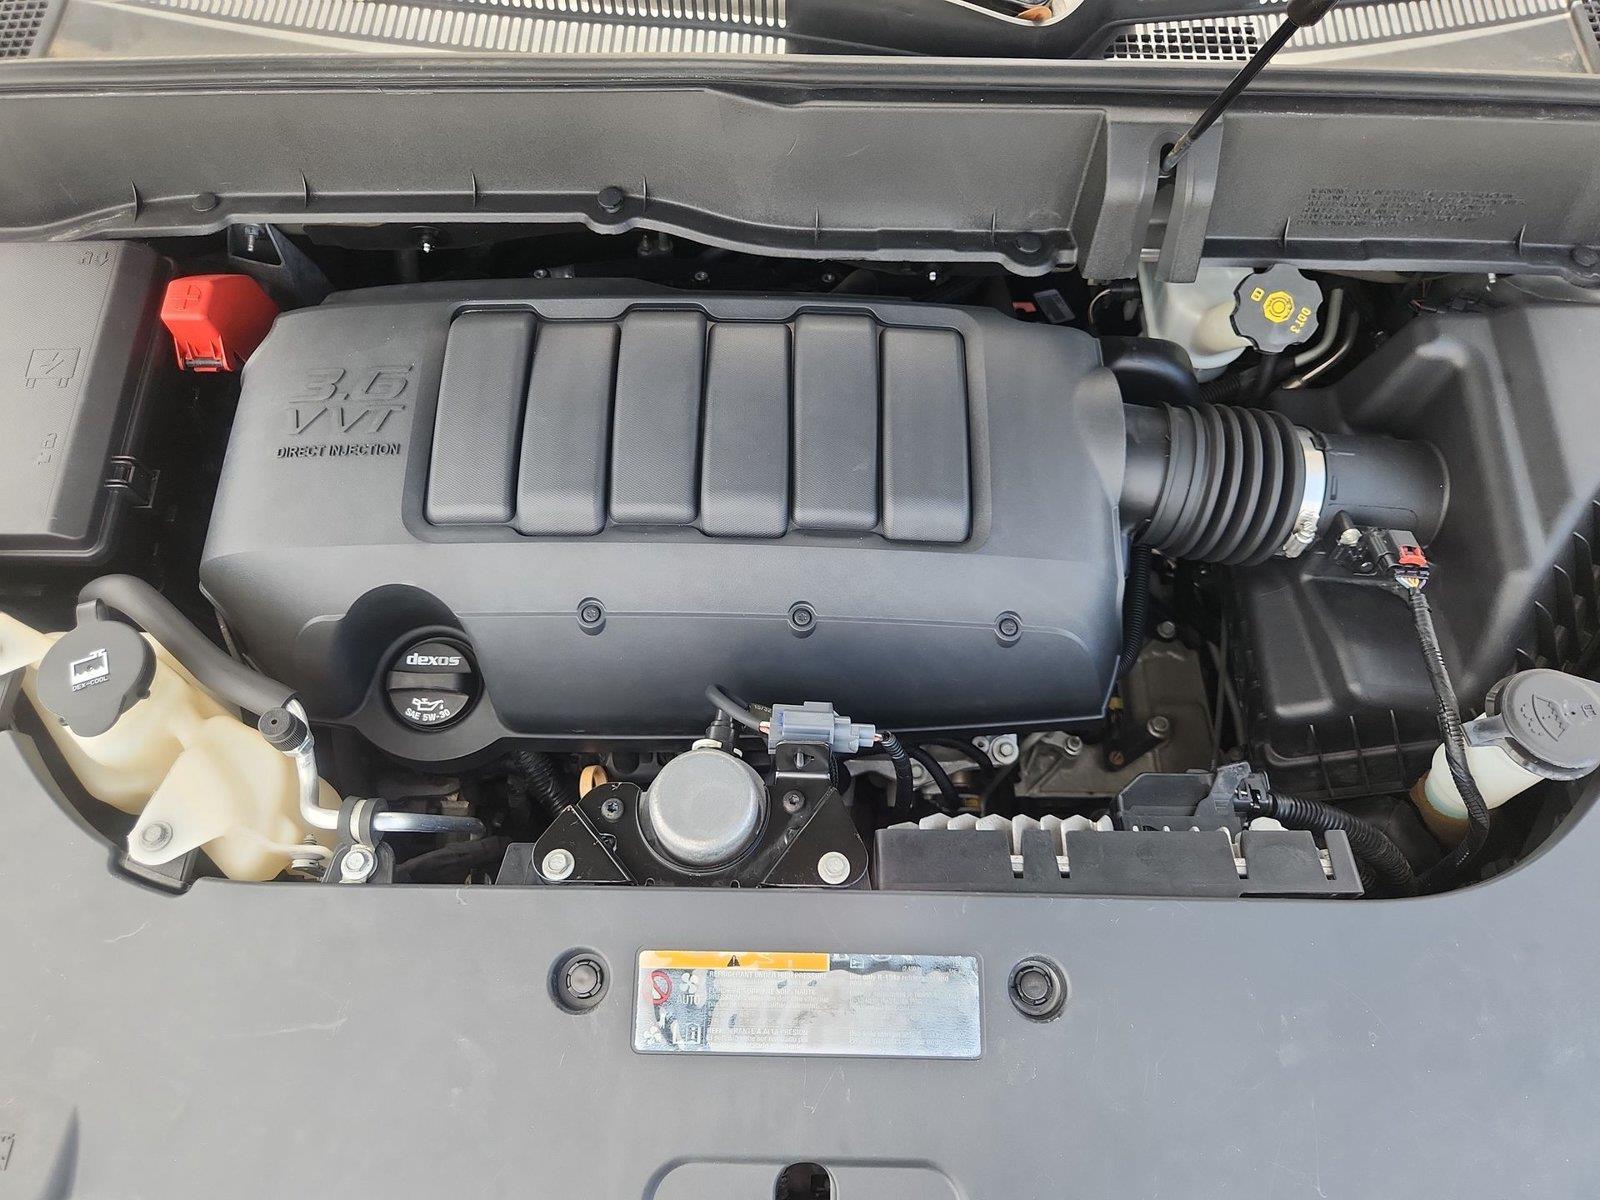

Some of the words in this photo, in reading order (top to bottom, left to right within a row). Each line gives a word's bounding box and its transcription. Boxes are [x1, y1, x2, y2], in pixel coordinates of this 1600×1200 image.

[289, 365, 412, 403] 3.6
[285, 404, 406, 435] VVT
[277, 444, 327, 458] DIRECT
[329, 443, 401, 456] INJECTION
[406, 652, 462, 666] dexos
[405, 707, 421, 721] SAE
[422, 708, 451, 722] 5W-30
